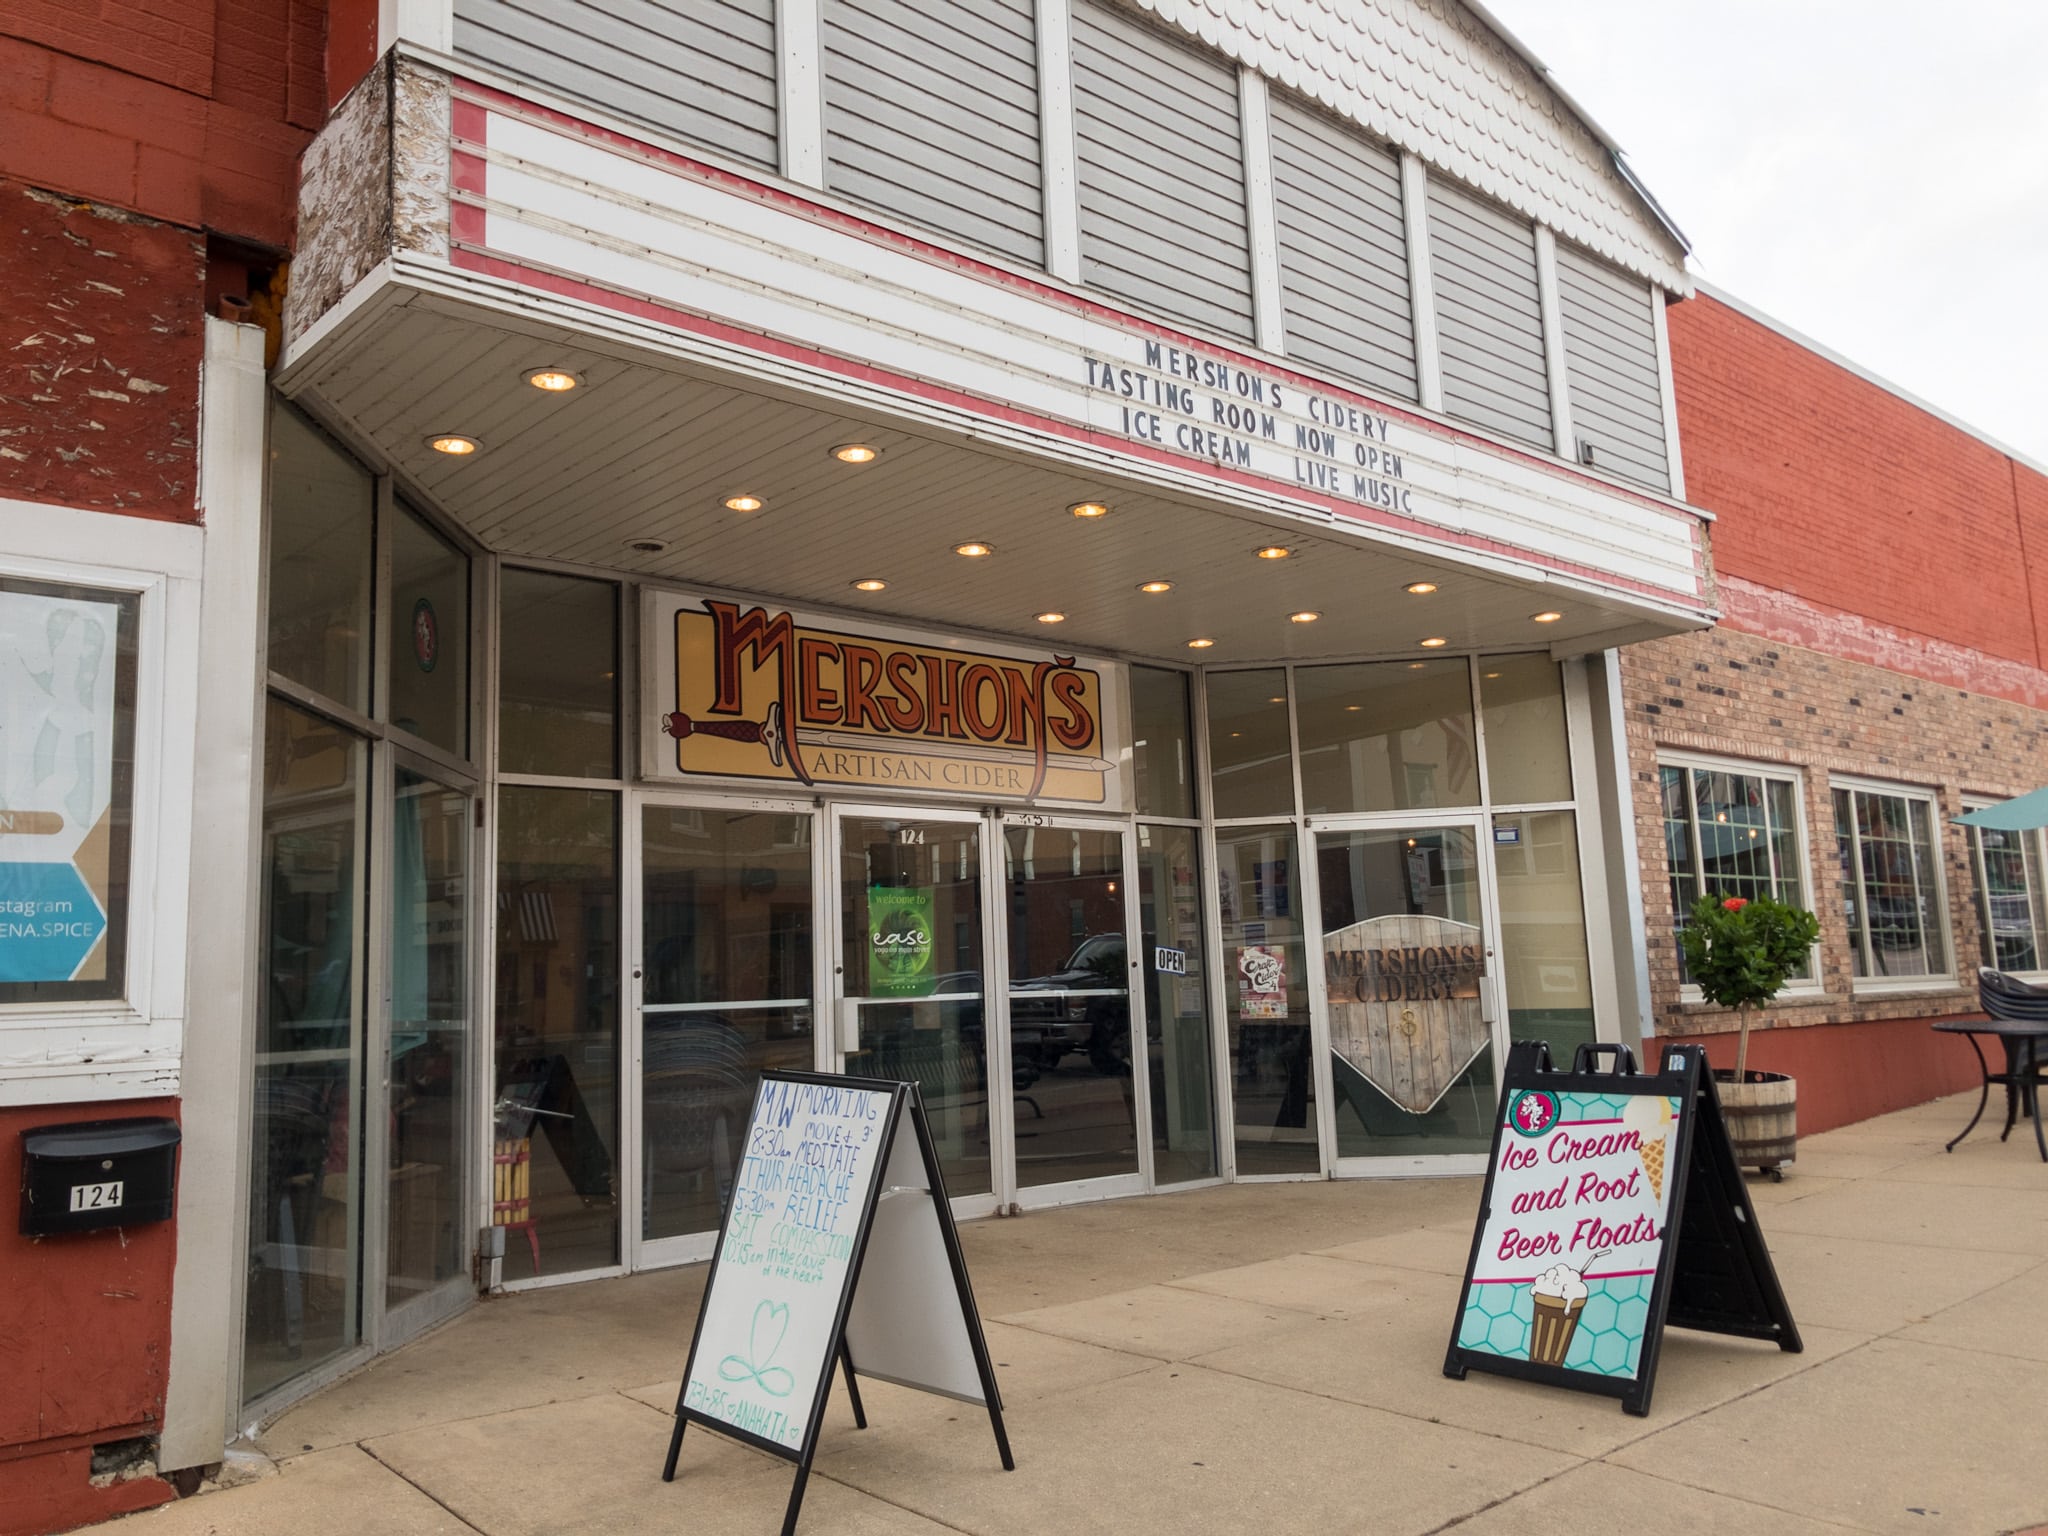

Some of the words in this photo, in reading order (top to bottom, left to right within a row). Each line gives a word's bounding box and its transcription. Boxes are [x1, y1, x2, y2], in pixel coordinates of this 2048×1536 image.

[1146, 340, 1282, 408] MERSHONS
[1309, 396, 1388, 442] CIDERY
[1084, 357, 1194, 415] TASTING
[1213, 397, 1275, 440] ROOM
[1296, 424, 1336, 458] NOW
[1355, 444, 1402, 479] OPEN
[1123, 407, 1162, 442] ICE
[1177, 424, 1250, 468] CREAM
[1295, 456, 1339, 492] LIVE
[1354, 477, 1413, 513] MUSIC
[813, 753, 932, 783] ARTISAN
[943, 763, 1024, 789] CIDER
[900, 830, 924, 845] 124
[875, 894, 915, 904] welcome
[917, 895, 926, 904] to
[874, 930, 931, 945] ease
[1159, 949, 1184, 972] OPEN
[1327, 945, 1476, 977] MERSHONS
[1355, 973, 1456, 1003] CIDERY
[797, 1085, 879, 1120] MORNING
[805, 1121, 842, 1143] MOVE
[795, 1141, 860, 1175] MEDITATE
[1500, 1140, 1539, 1172] Ice
[1547, 1130, 1644, 1163] Cream
[76, 1184, 119, 1208] 124
[745, 1156, 785, 1192] THUR
[785, 1162, 854, 1203] HEADACHE
[1511, 1176, 1569, 1214] and
[1575, 1167, 1640, 1205] Root
[729, 1212, 763, 1242] SAT
[783, 1194, 842, 1233] RELIEF
[1497, 1228, 1562, 1261] Beer
[1569, 1212, 1661, 1253] Floats
